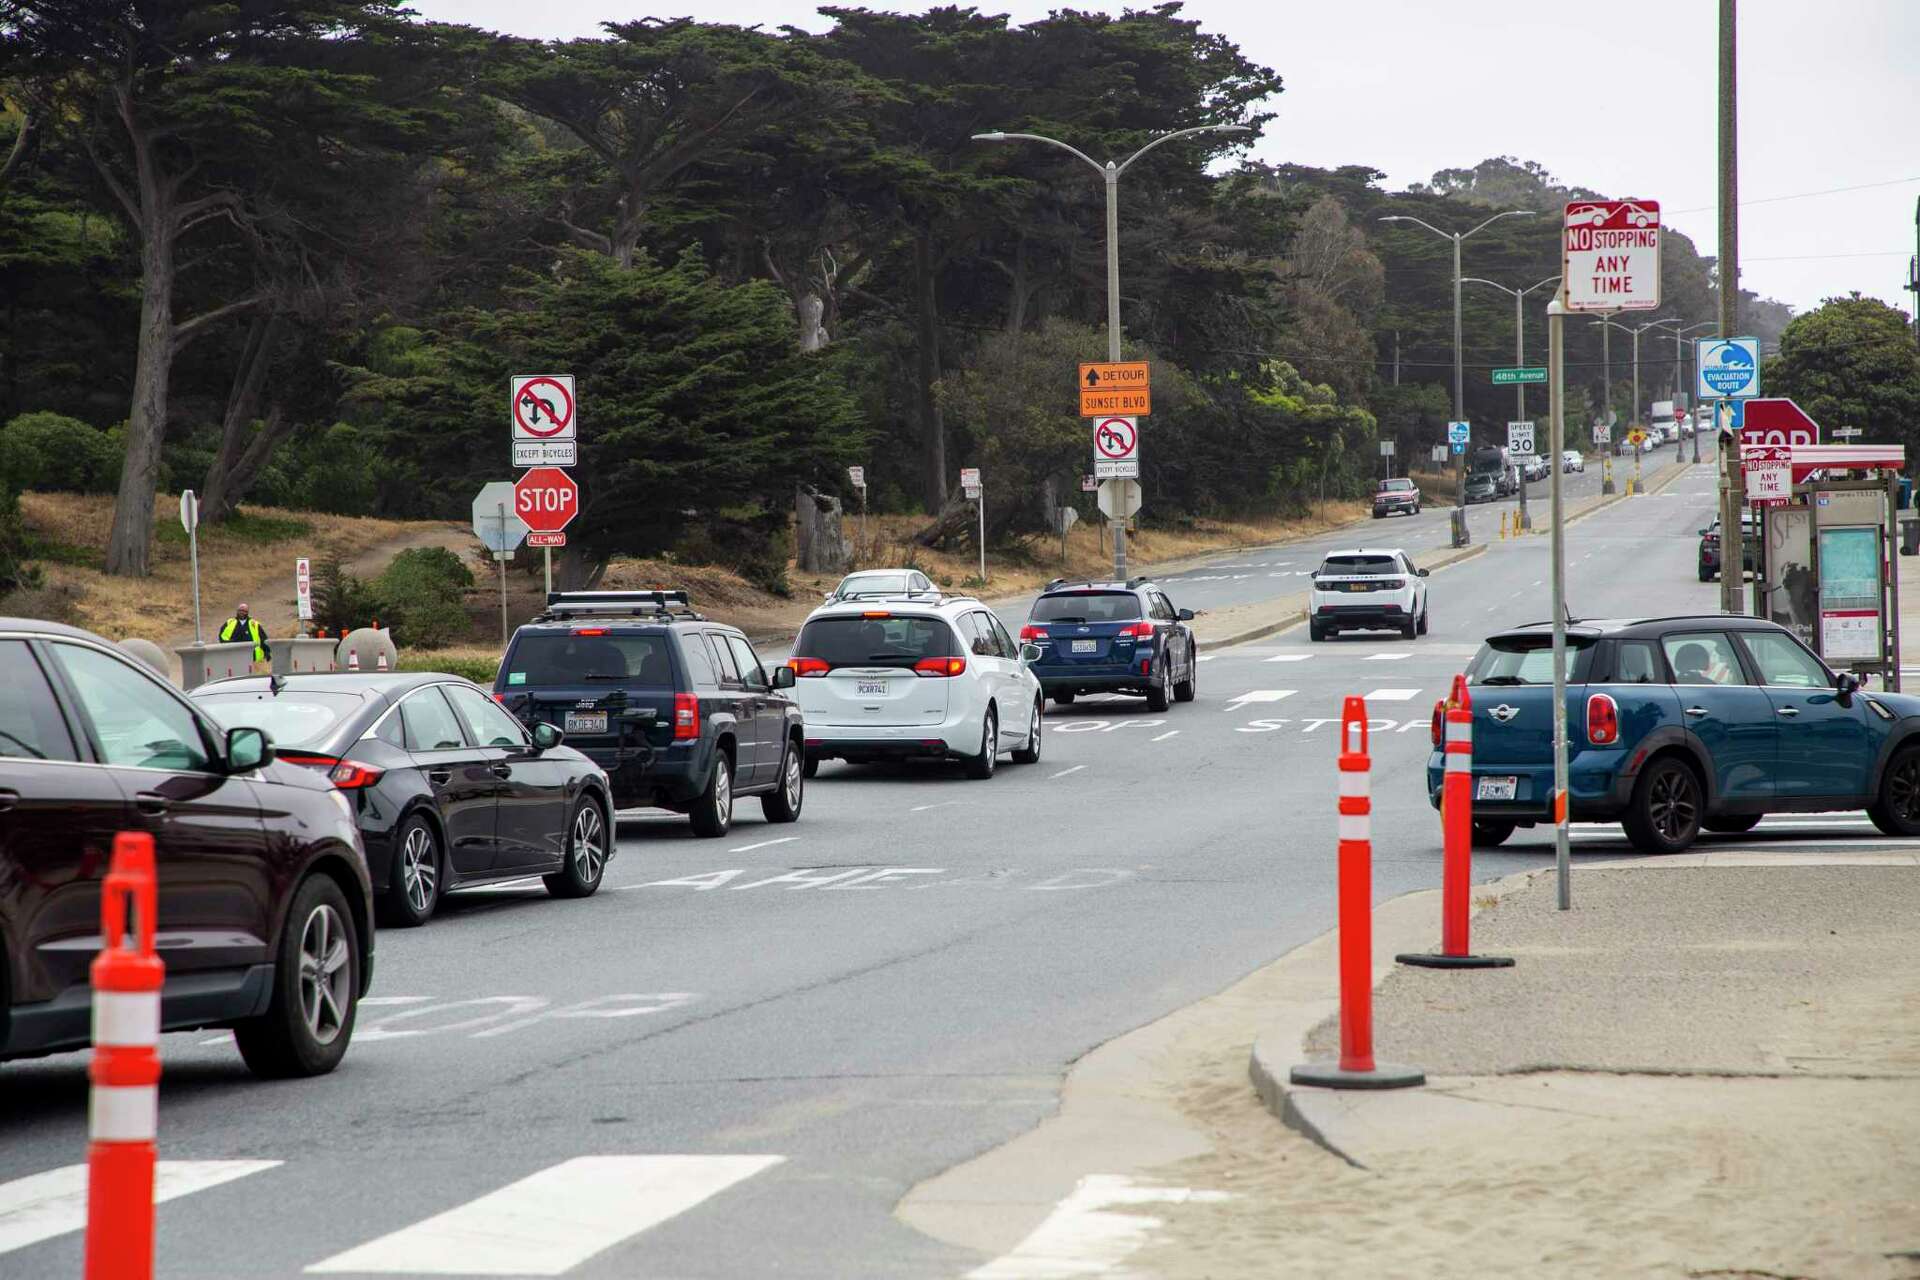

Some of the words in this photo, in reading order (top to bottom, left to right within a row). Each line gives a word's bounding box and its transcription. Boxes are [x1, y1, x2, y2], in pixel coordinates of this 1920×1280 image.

[1568, 228, 1592, 250] NO
[1594, 231, 1656, 249] STOPPING
[1595, 255, 1630, 273] ANY
[1592, 276, 1633, 294] TIME
[1103, 370, 1145, 381] DETOUR
[1495, 372, 1516, 381] 48th
[1519, 371, 1544, 380] Avenue
[1707, 372, 1750, 382] EVACUATION
[1717, 381, 1740, 390] ROUTE
[1085, 397, 1119, 410] SUNSET
[1123, 396, 1146, 409] BLVD
[1744, 430, 1811, 446] TOP
[1511, 439, 1532, 452] 30
[516, 449, 539, 459] EXCEPT
[542, 449, 573, 459] BICYCLES
[1747, 460, 1759, 471] NO
[1760, 460, 1790, 471] STOPPING
[1760, 473, 1778, 482] ANY
[1759, 483, 1779, 492] TIME
[519, 487, 573, 512] STOP
[529, 535, 563, 545] ALL-WAY
[857, 685, 887, 694] 9CXR741
